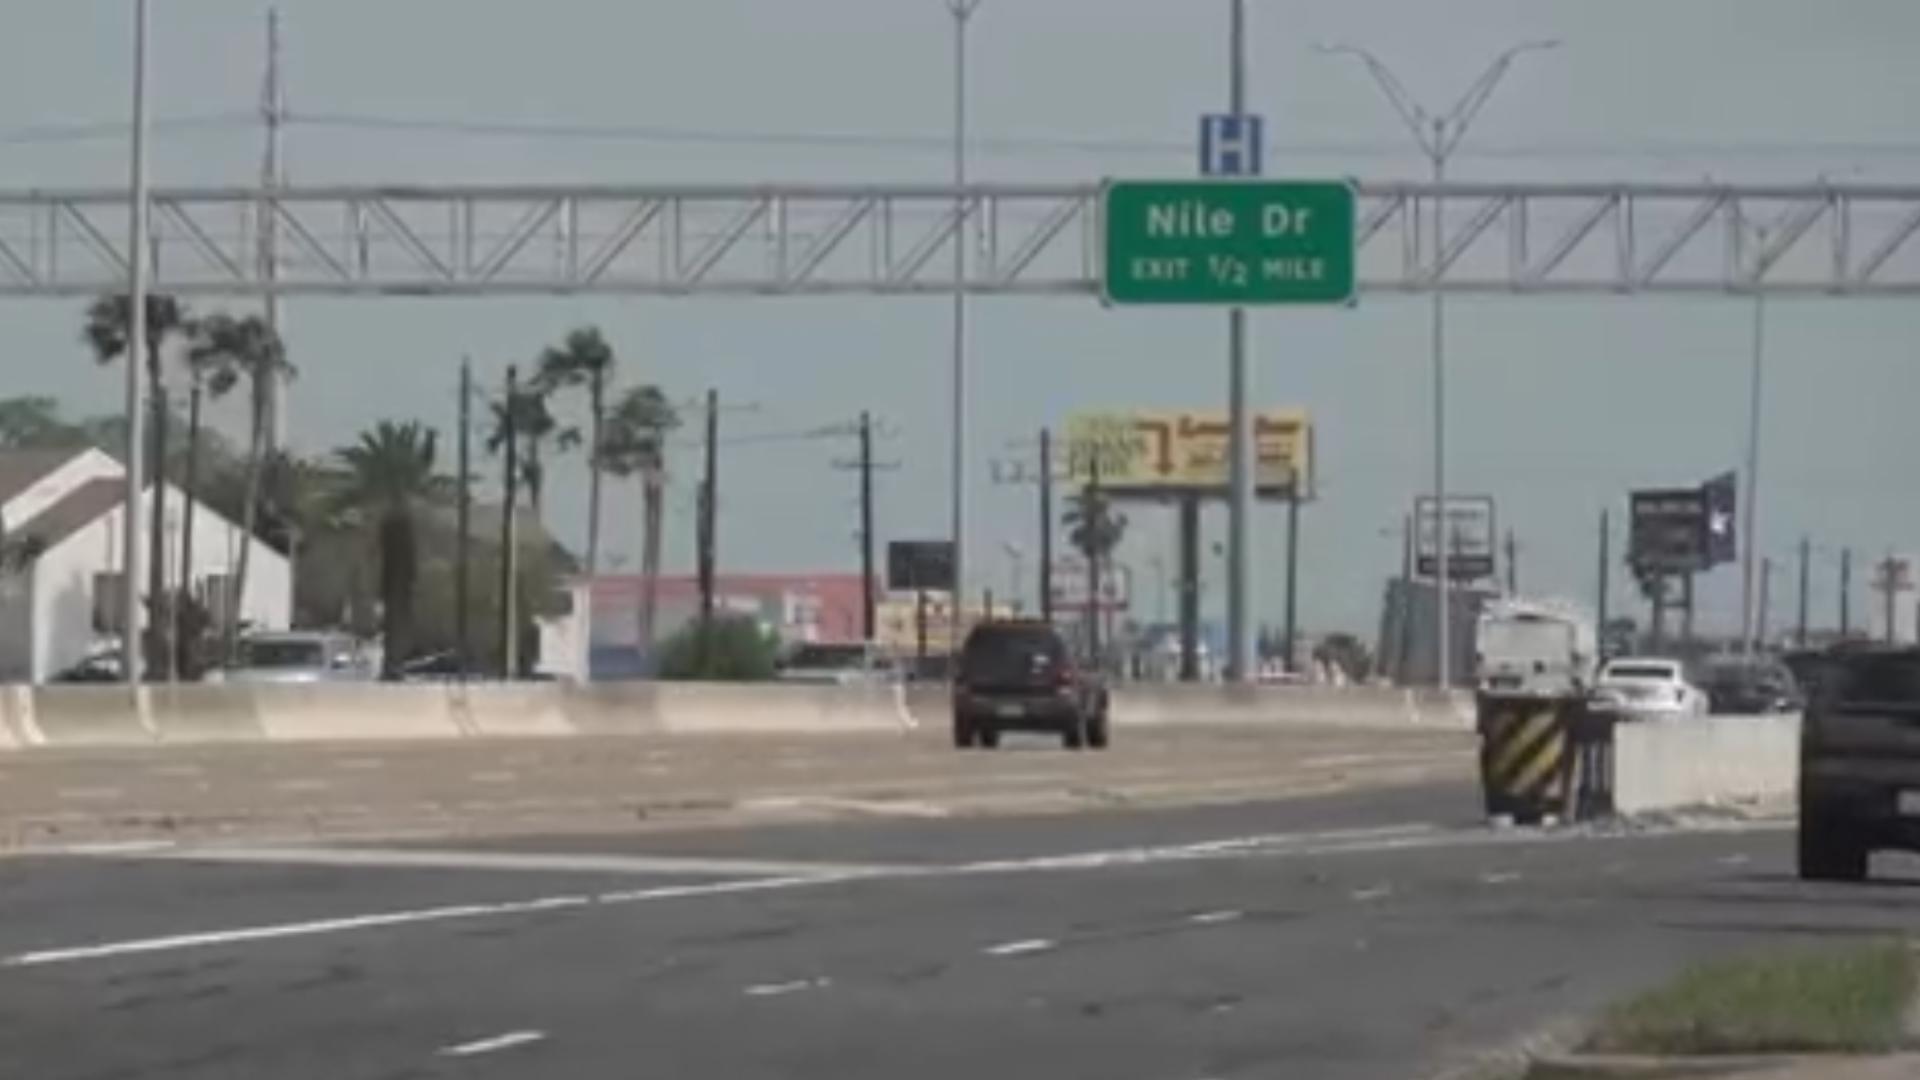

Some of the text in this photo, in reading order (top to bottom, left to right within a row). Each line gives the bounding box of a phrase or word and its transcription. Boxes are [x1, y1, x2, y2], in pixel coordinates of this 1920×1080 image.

[1209, 116, 1250, 175] H
[1146, 202, 1311, 237] Nile Dr
[1131, 257, 1189, 280] EXIT
[1262, 257, 1324, 280] MILE
